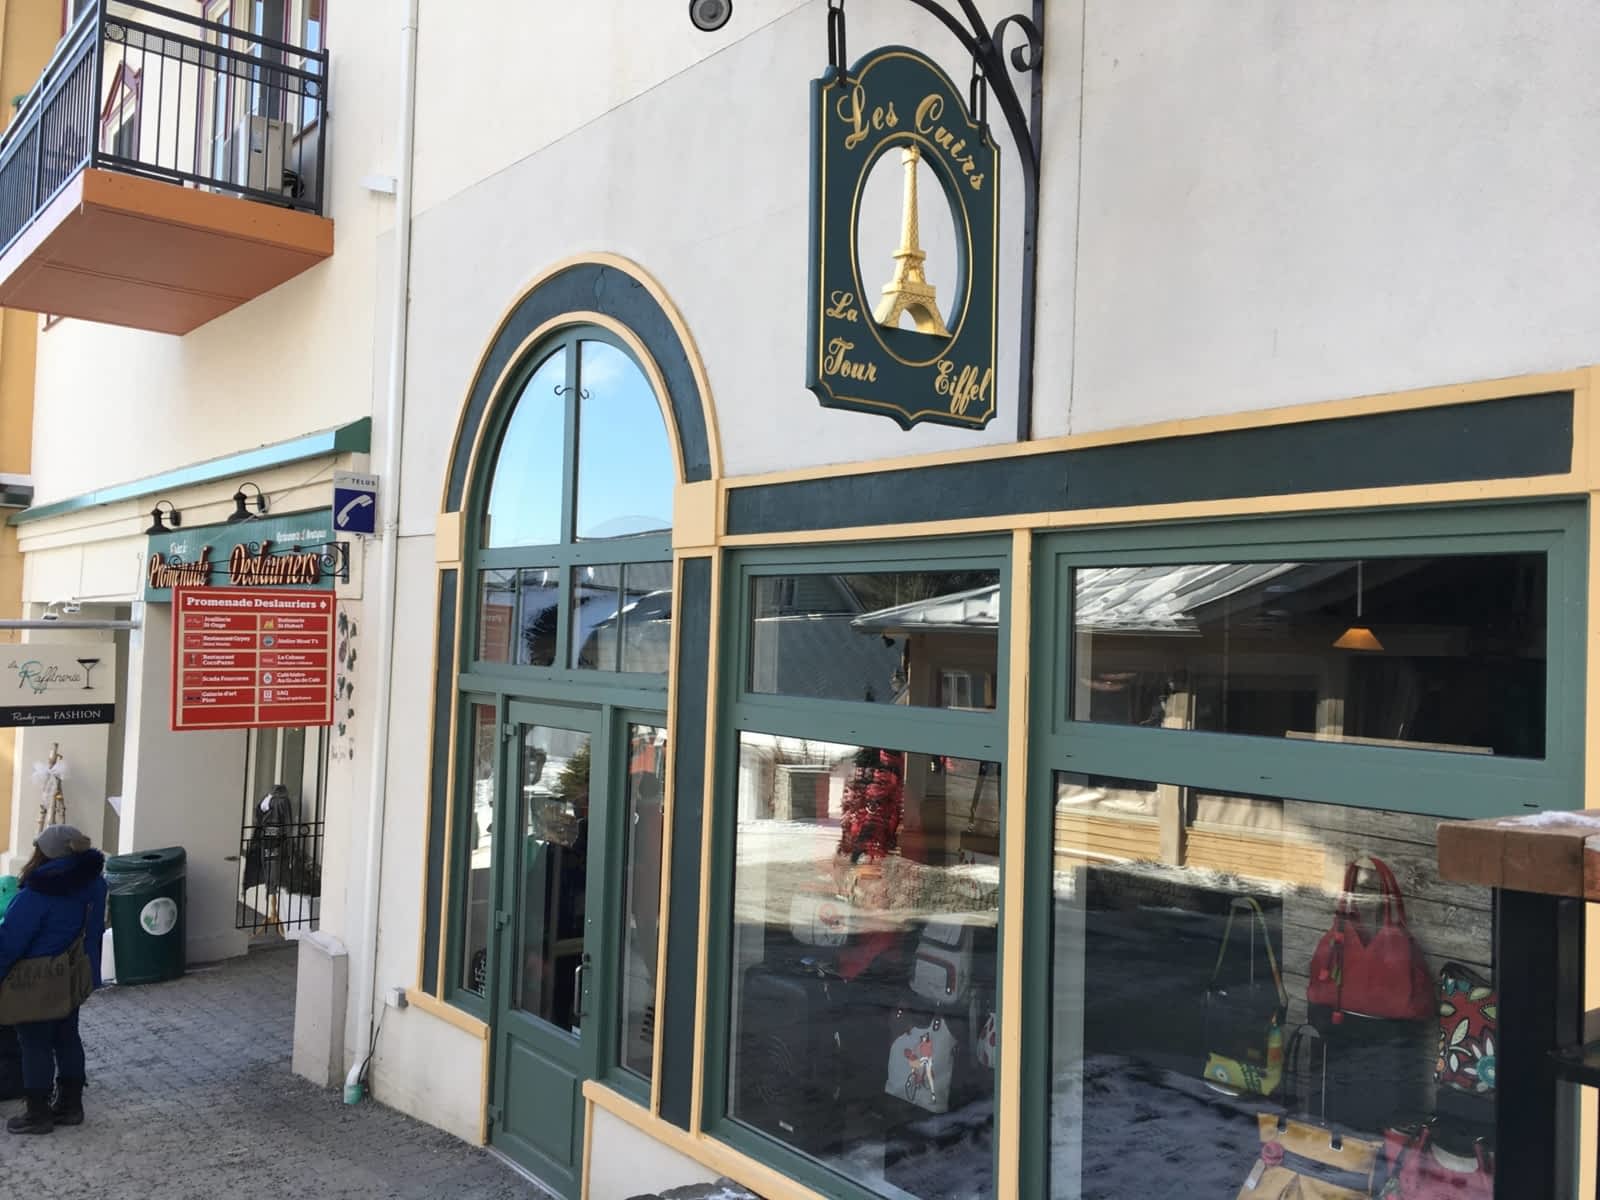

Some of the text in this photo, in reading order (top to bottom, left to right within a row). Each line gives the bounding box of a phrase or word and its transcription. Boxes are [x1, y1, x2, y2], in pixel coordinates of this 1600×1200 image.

[837, 84, 984, 190] Les Cuirs
[826, 291, 858, 322] La
[824, 337, 877, 383] Tour
[935, 360, 992, 415] Eiffel
[230, 541, 319, 586] Deslauriers
[187, 597, 317, 608] Promenade Deslauriers
[54, 709, 101, 720] FASHION
